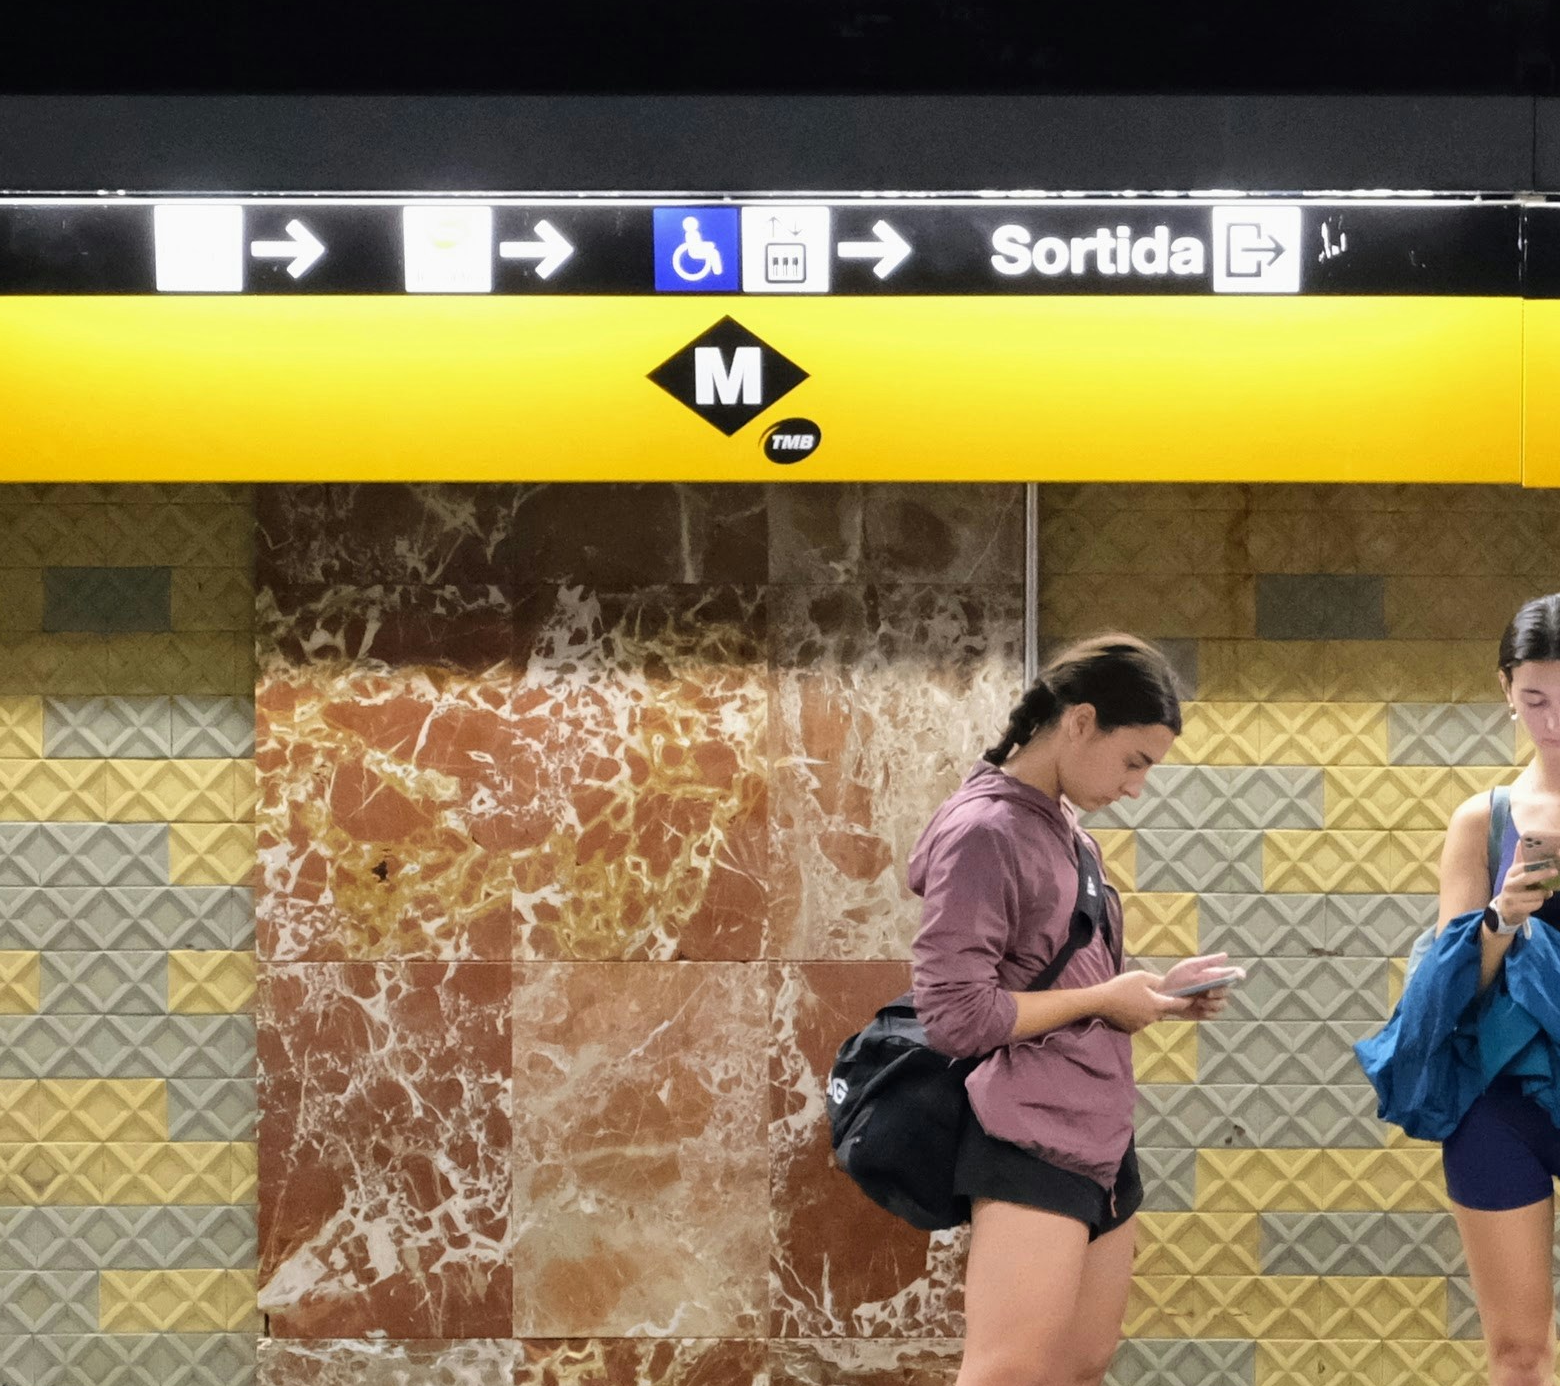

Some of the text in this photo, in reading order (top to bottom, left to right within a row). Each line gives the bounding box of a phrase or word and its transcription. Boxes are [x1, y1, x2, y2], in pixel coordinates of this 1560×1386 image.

[991, 224, 1204, 275] Sortida
[695, 346, 761, 405] M
[772, 434, 816, 450] TMB
